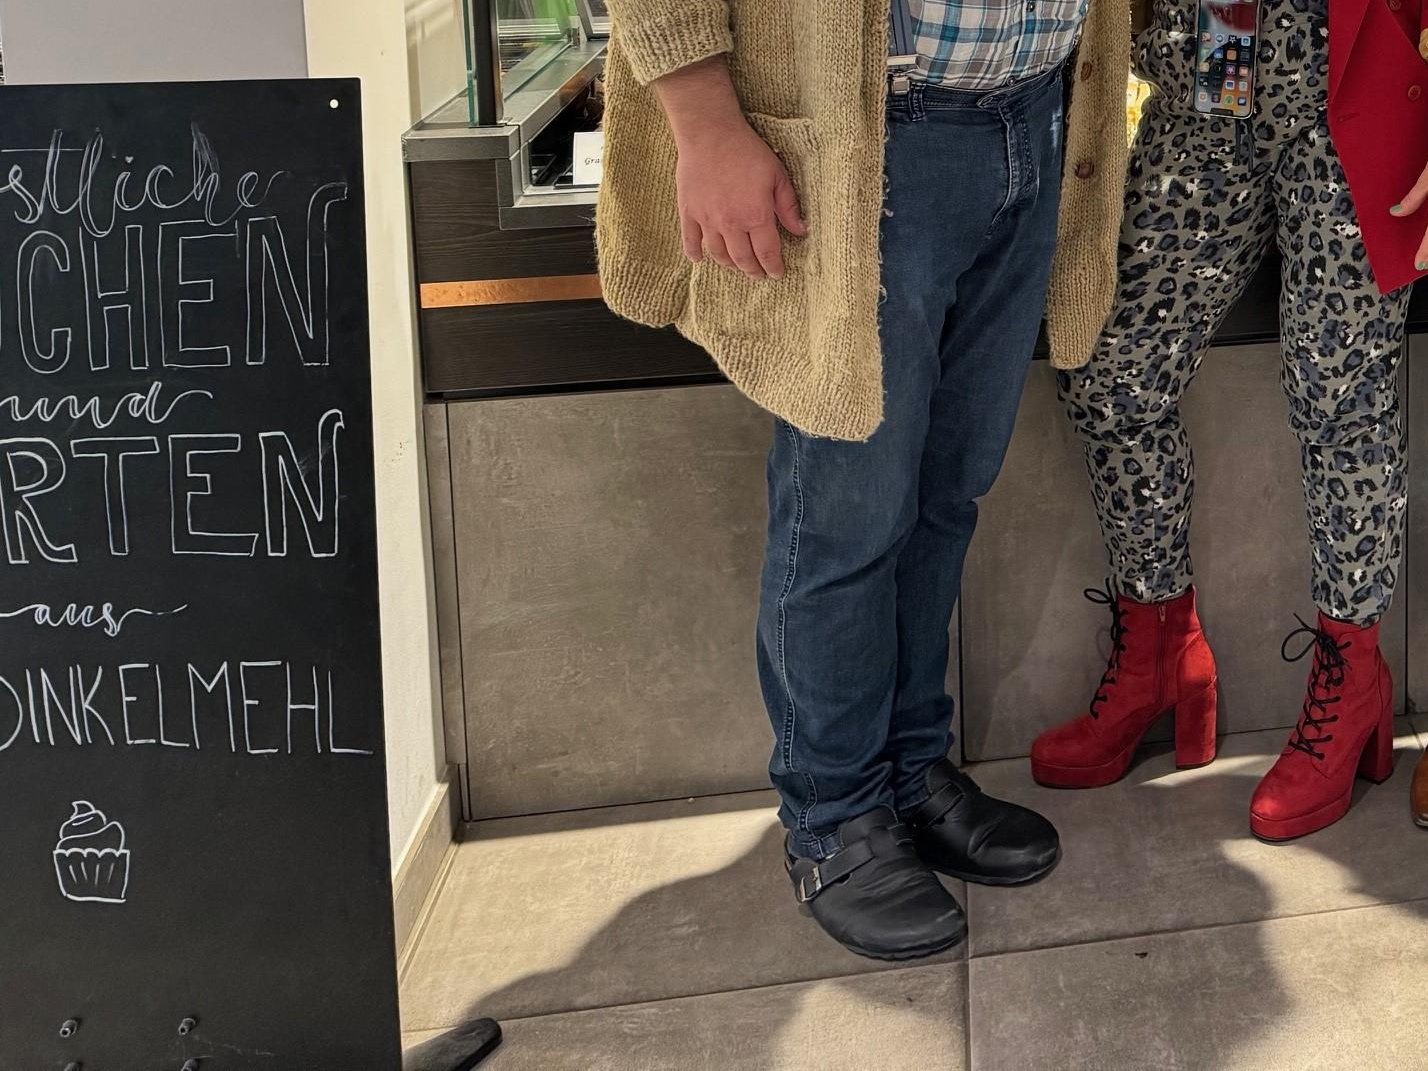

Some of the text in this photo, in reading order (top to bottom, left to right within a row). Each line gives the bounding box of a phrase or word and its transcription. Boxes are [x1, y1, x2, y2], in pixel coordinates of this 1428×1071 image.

[0, 122, 289, 237] stliche
[17, 181, 348, 374] CHEN
[0, 408, 345, 564] RTEN
